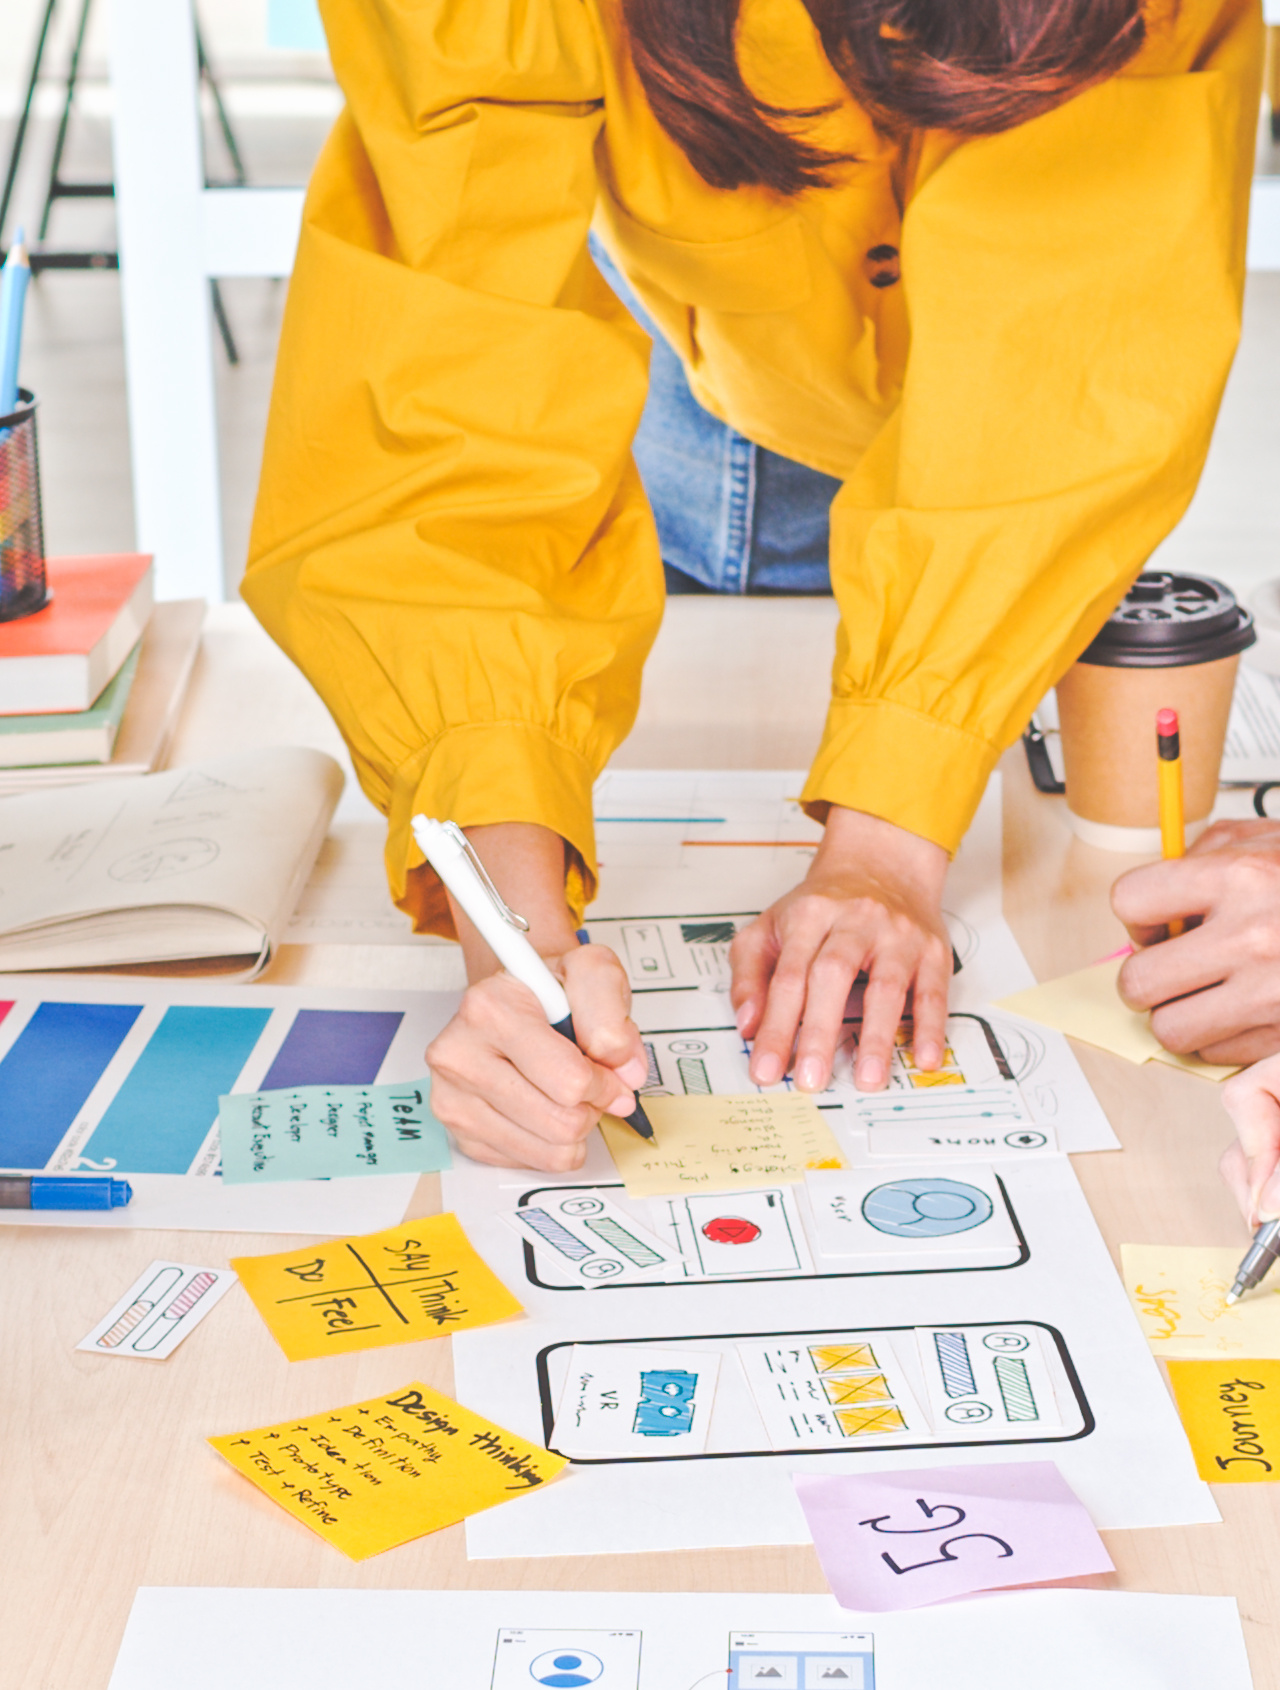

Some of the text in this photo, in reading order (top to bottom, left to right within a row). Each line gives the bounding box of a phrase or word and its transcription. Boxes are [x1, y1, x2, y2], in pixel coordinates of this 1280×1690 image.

[284, 1258, 326, 1282] Do
[311, 1297, 382, 1336] Feel
[411, 1279, 468, 1325] Think
[600, 1390, 619, 1410] VR
[1215, 1378, 1272, 1473] Journey
[373, 1415, 445, 1465] Empathy
[386, 1389, 545, 1491] Design thinking
[249, 1450, 286, 1477] Test
[292, 1487, 339, 1526] Refine
[278, 1443, 353, 1500] Prototype
[858, 1498, 1014, 1575] 5G
